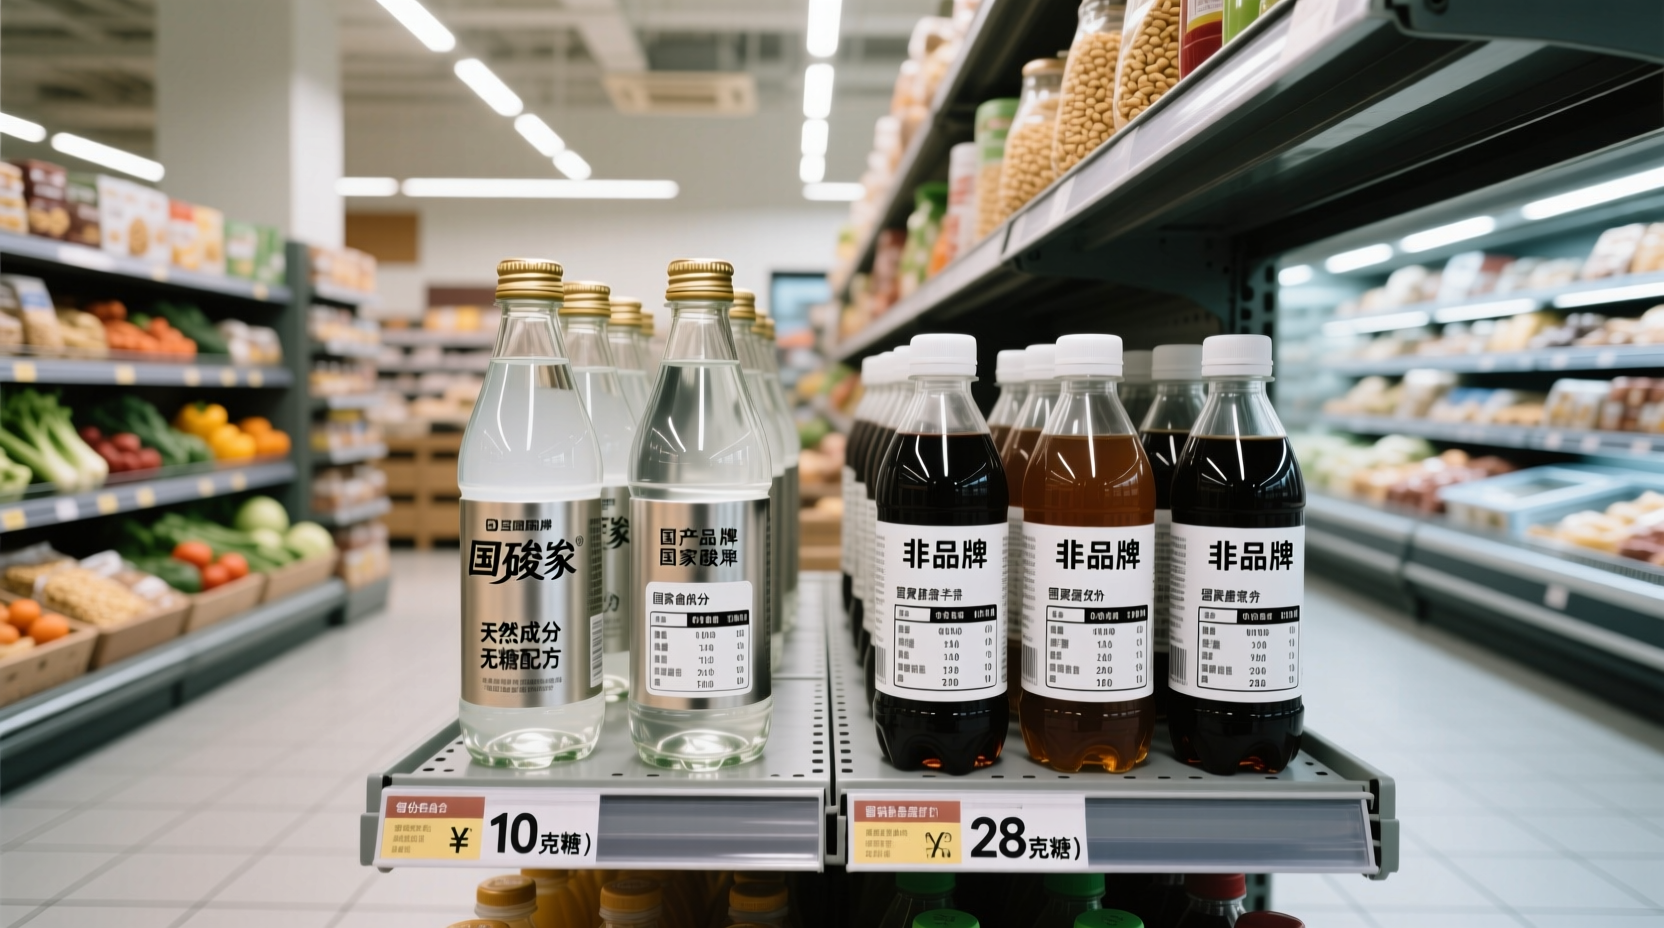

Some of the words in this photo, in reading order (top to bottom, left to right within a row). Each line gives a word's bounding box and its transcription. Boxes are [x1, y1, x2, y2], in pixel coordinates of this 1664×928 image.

[660, 527, 738, 548] 国产品牌
[903, 538, 988, 570] 非品牌
[1056, 538, 1141, 571] 非品牌
[1208, 540, 1293, 571] 非品牌
[480, 621, 562, 644] 天然成分
[480, 647, 562, 670] 无糖配方
